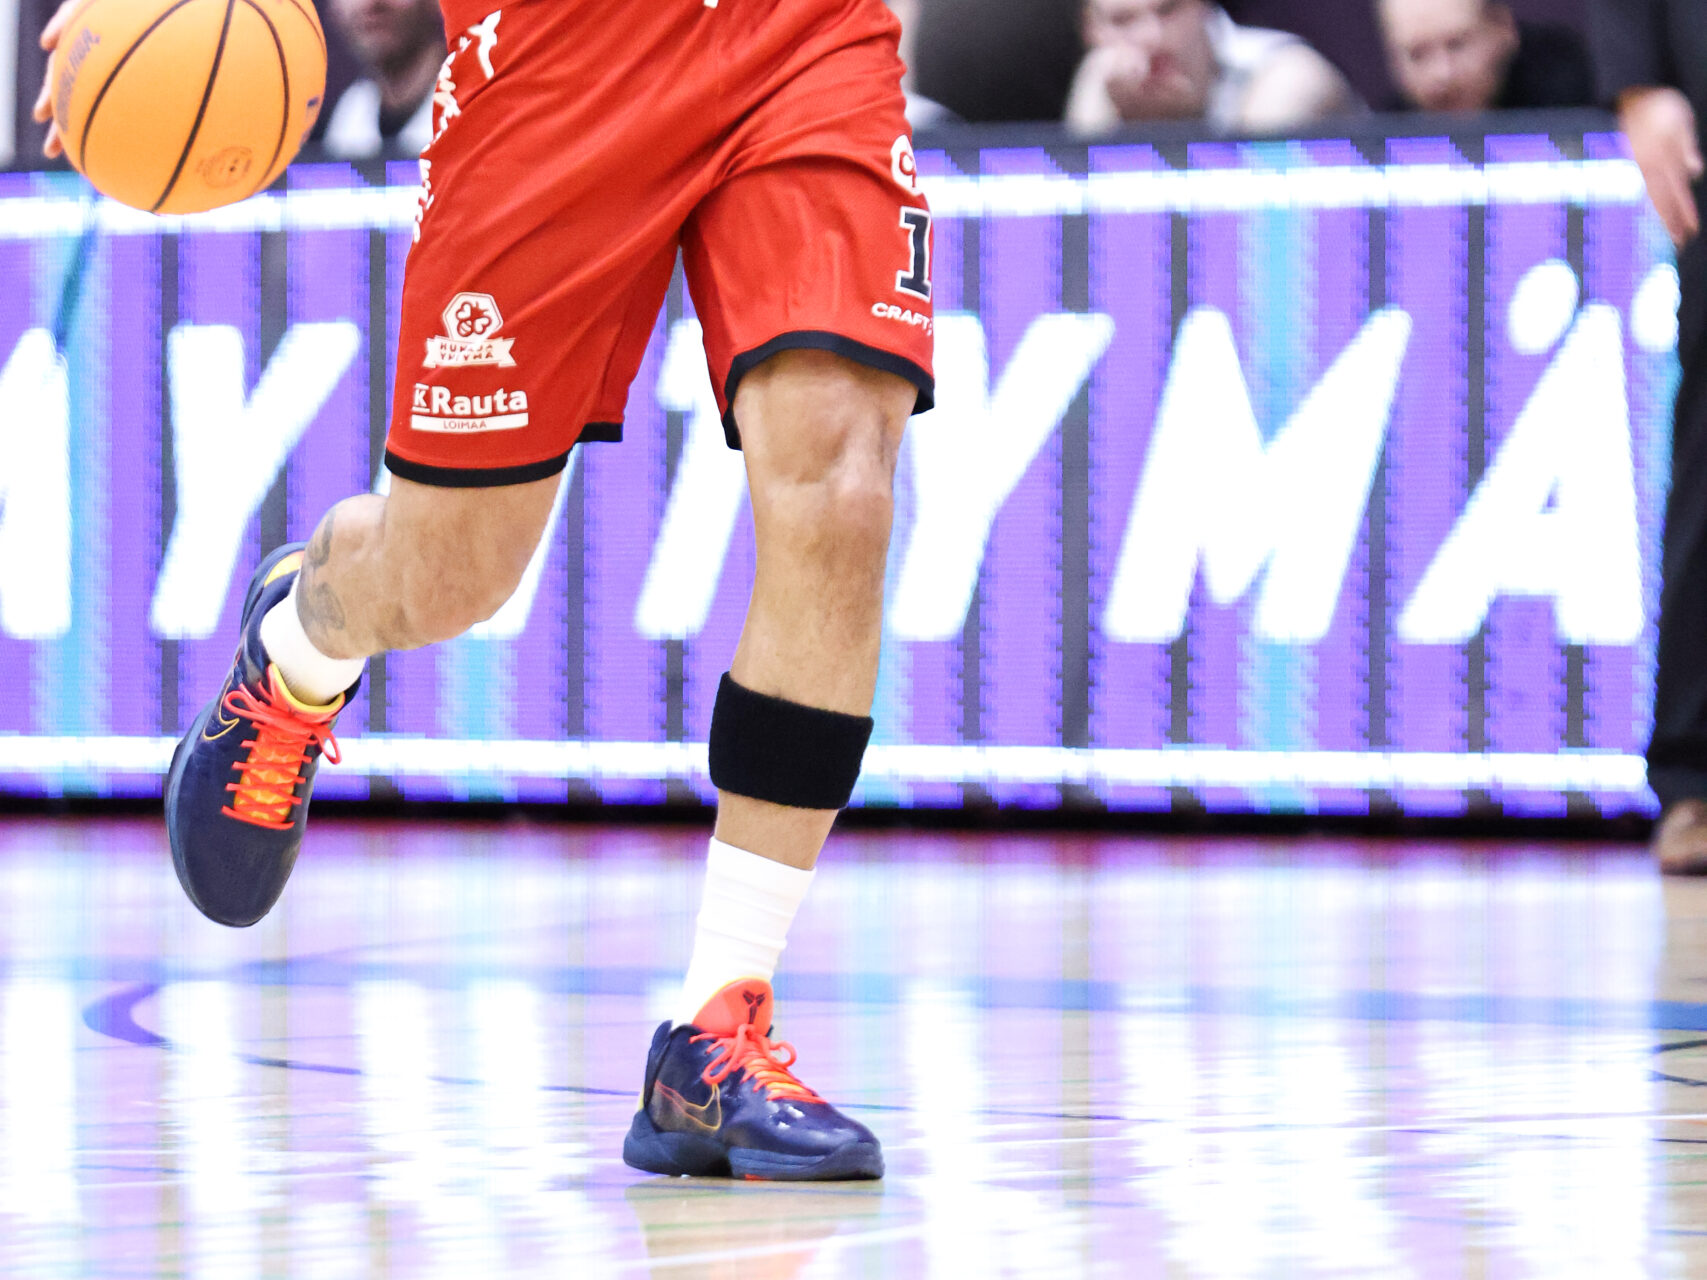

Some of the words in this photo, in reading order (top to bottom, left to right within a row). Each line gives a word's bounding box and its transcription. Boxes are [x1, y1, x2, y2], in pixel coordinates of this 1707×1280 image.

[895, 206, 932, 303] 1
[871, 302, 930, 331] CRAFT
[0, 257, 1680, 644] YTYMÄ
[444, 419, 487, 430] LOIMAA
